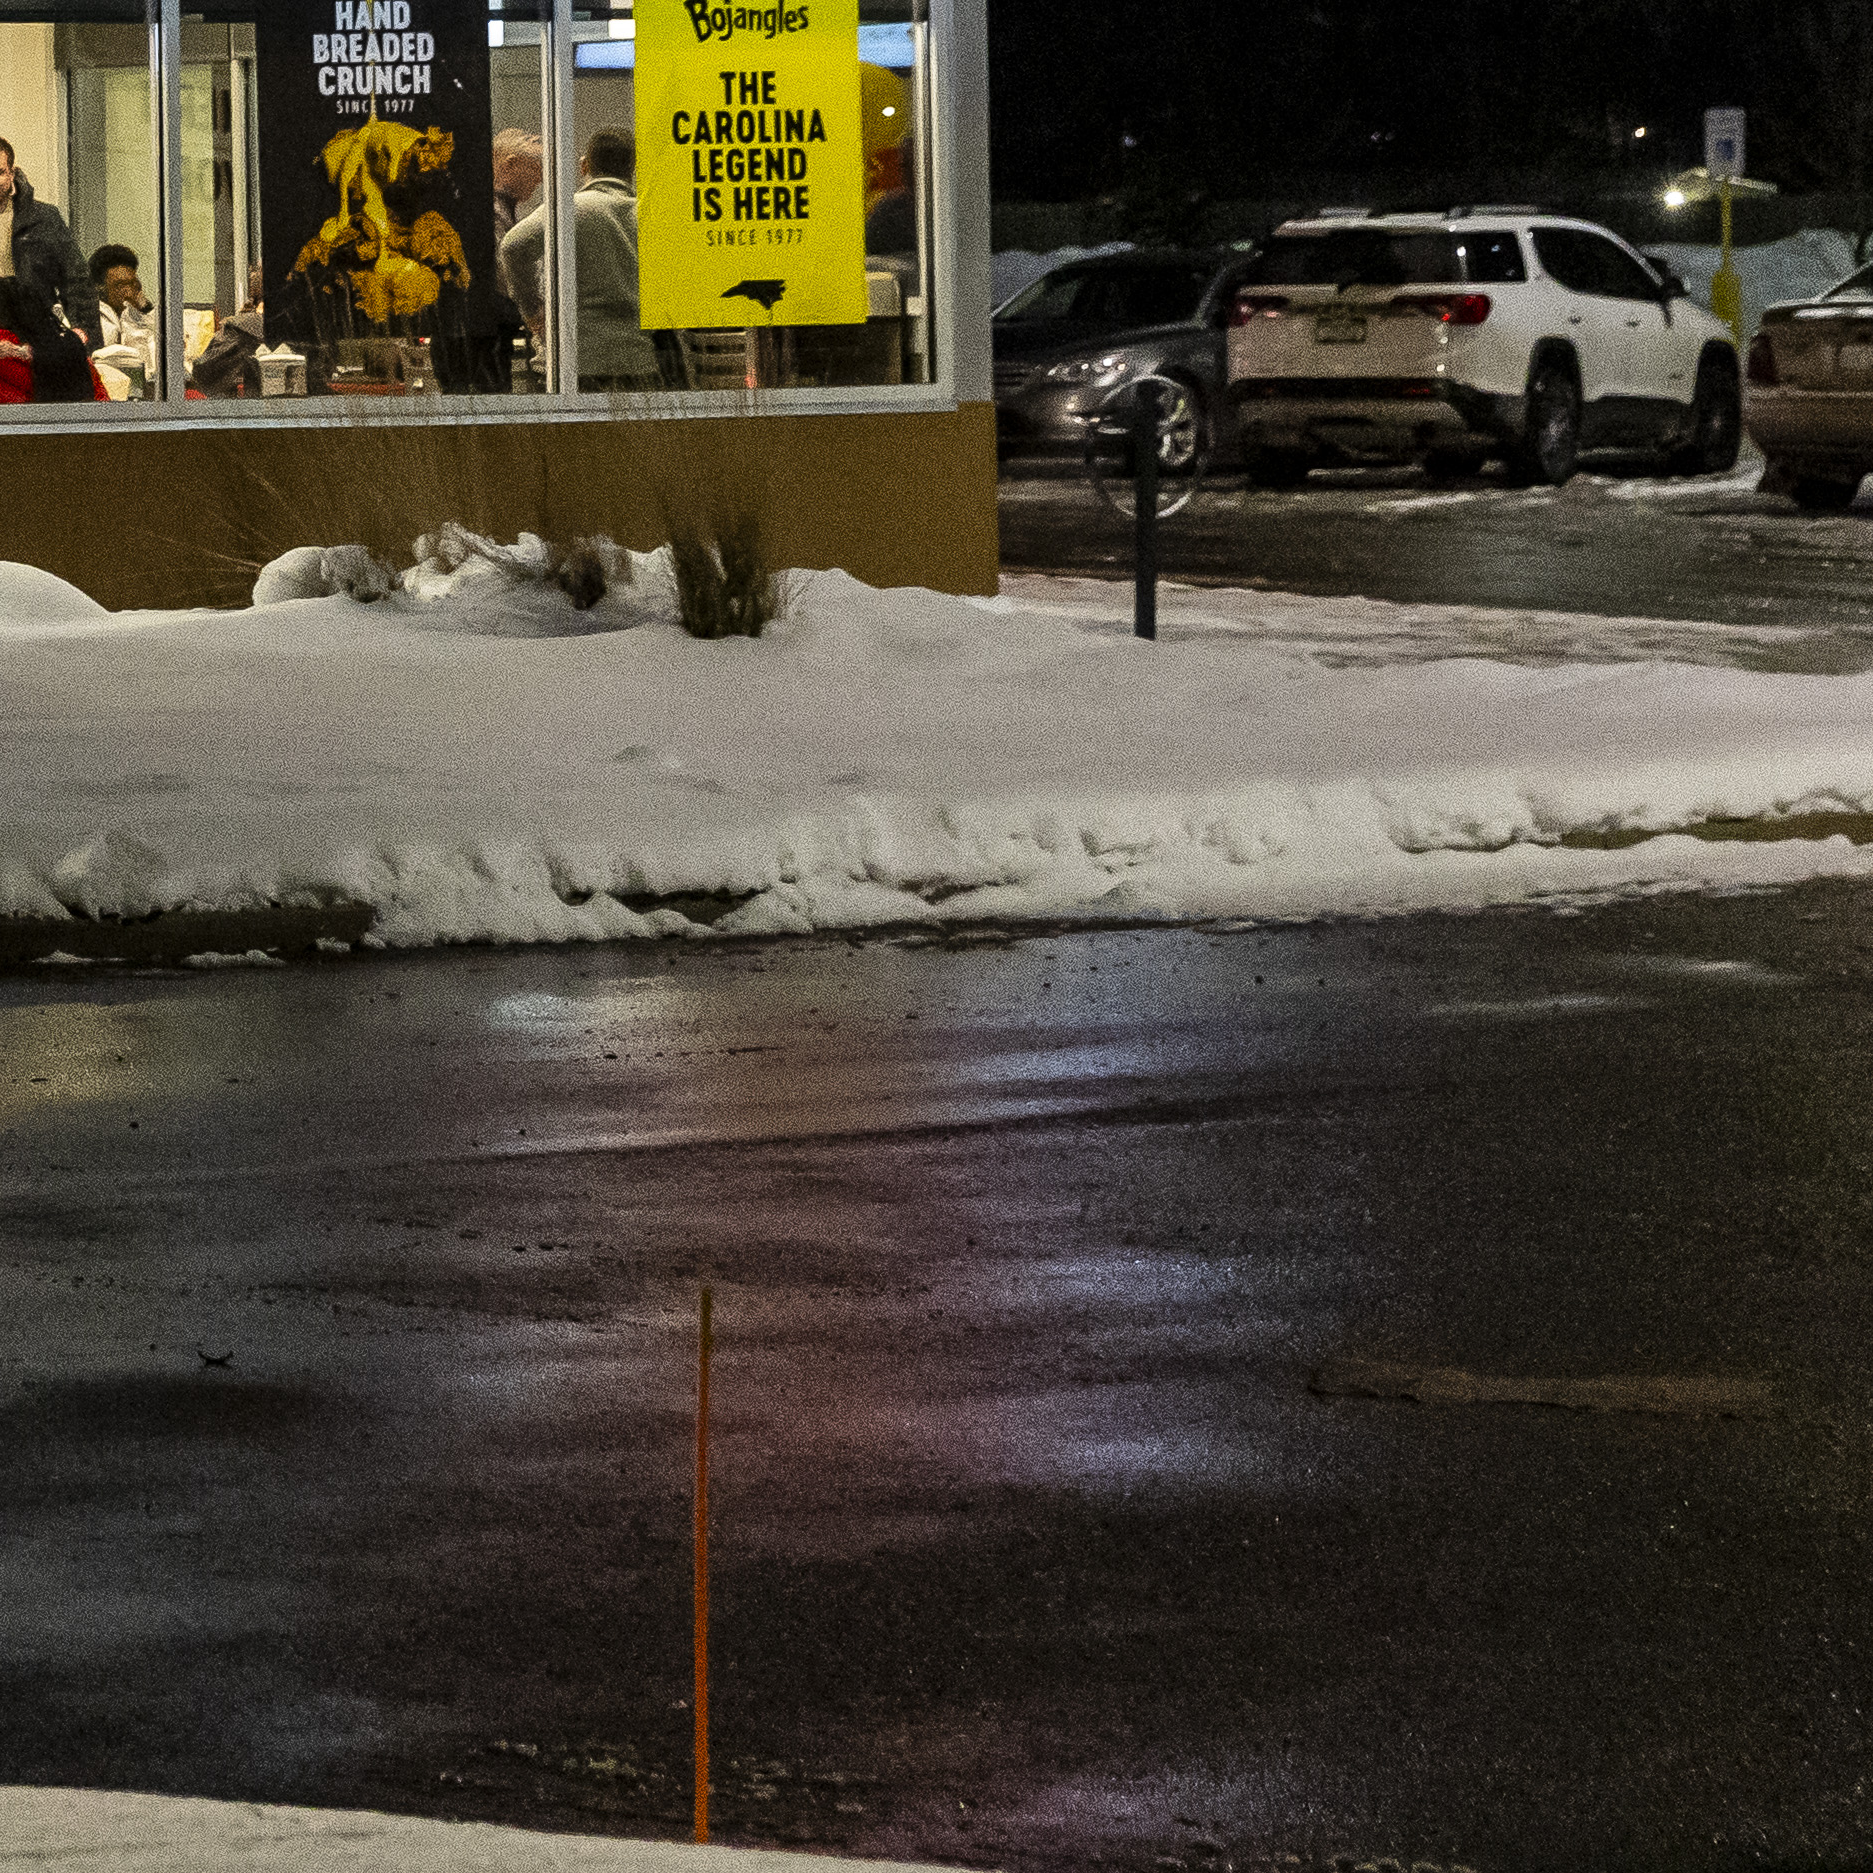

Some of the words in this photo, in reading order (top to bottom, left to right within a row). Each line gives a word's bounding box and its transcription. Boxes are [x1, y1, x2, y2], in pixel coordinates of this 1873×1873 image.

[335, 0, 411, 30] HAND
[313, 32, 435, 63] BREADED
[318, 65, 432, 96] CRUNCH
[719, 71, 776, 105] THE
[336, 99, 376, 114] SINC
[384, 99, 414, 113] 1977
[671, 109, 827, 145] CAROLINA
[692, 147, 807, 183] LEGEND
[693, 187, 723, 222] IS
[733, 185, 810, 221] HERE
[705, 229, 756, 246] SINCE
[766, 228, 803, 244] 1977
